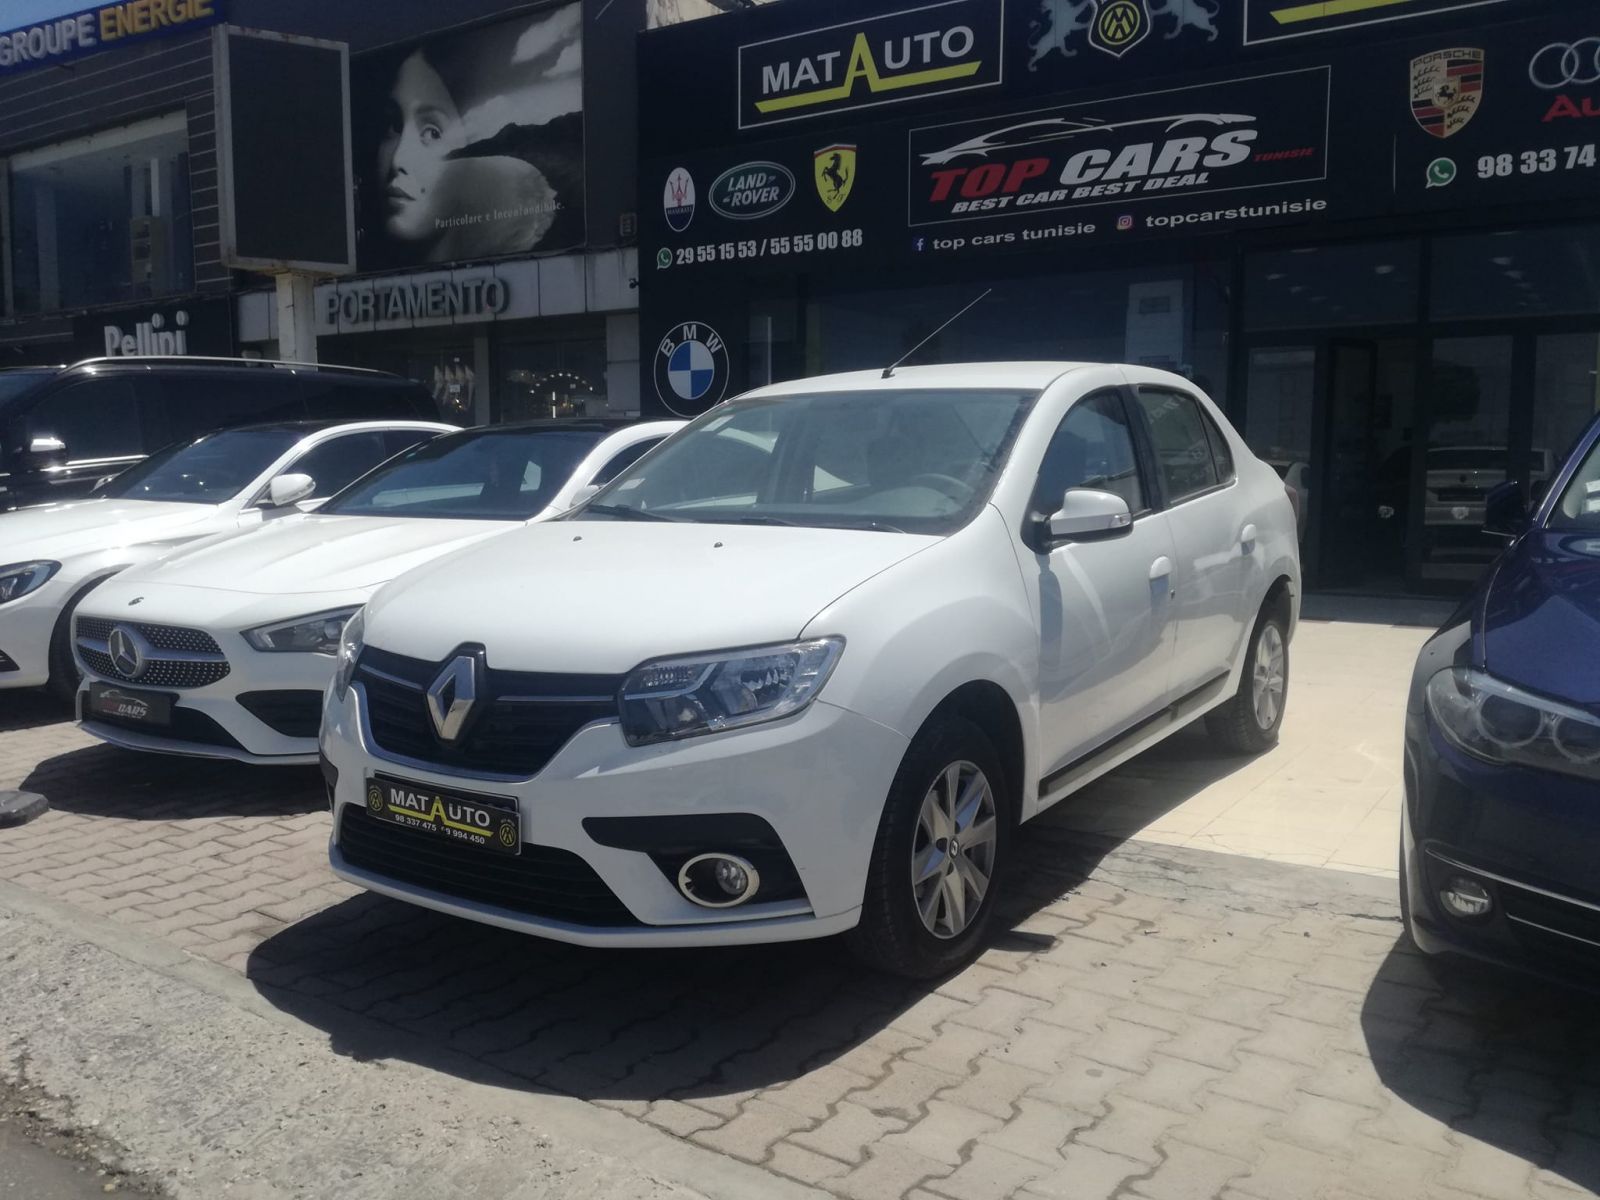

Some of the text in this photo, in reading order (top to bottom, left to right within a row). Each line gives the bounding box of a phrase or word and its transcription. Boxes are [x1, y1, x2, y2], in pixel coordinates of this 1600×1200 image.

[0, 0, 214, 66] GROUPE ENERGIE
[1412, 49, 1482, 69] PORSCHE
[929, 129, 1316, 202] TOP CARS TUNISIE
[1477, 143, 1597, 179] 98 33 74
[727, 172, 767, 192] LAND
[731, 186, 780, 207] ROVER
[951, 172, 1210, 213] BEST CAR BEST DEAL
[1145, 199, 1327, 229] topcarstunisie
[676, 248, 694, 265] 29
[697, 245, 715, 262] 55
[718, 243, 735, 260] 15
[738, 240, 757, 258] 53
[770, 237, 790, 255] 55
[793, 234, 814, 252] 55
[817, 231, 838, 250] 00
[841, 228, 862, 247] 88
[933, 238, 966, 250] top
[971, 232, 1015, 245] cars
[1022, 223, 1096, 241] tunisie
[326, 276, 508, 325] PORTAMENTO
[104, 310, 189, 357] Pellini
[661, 324, 722, 358] BMW
[395, 814, 405, 823] 98
[406, 817, 420, 827] 337
[422, 822, 437, 832] 475
[453, 830, 468, 840] 994
[470, 834, 485, 845] 450
